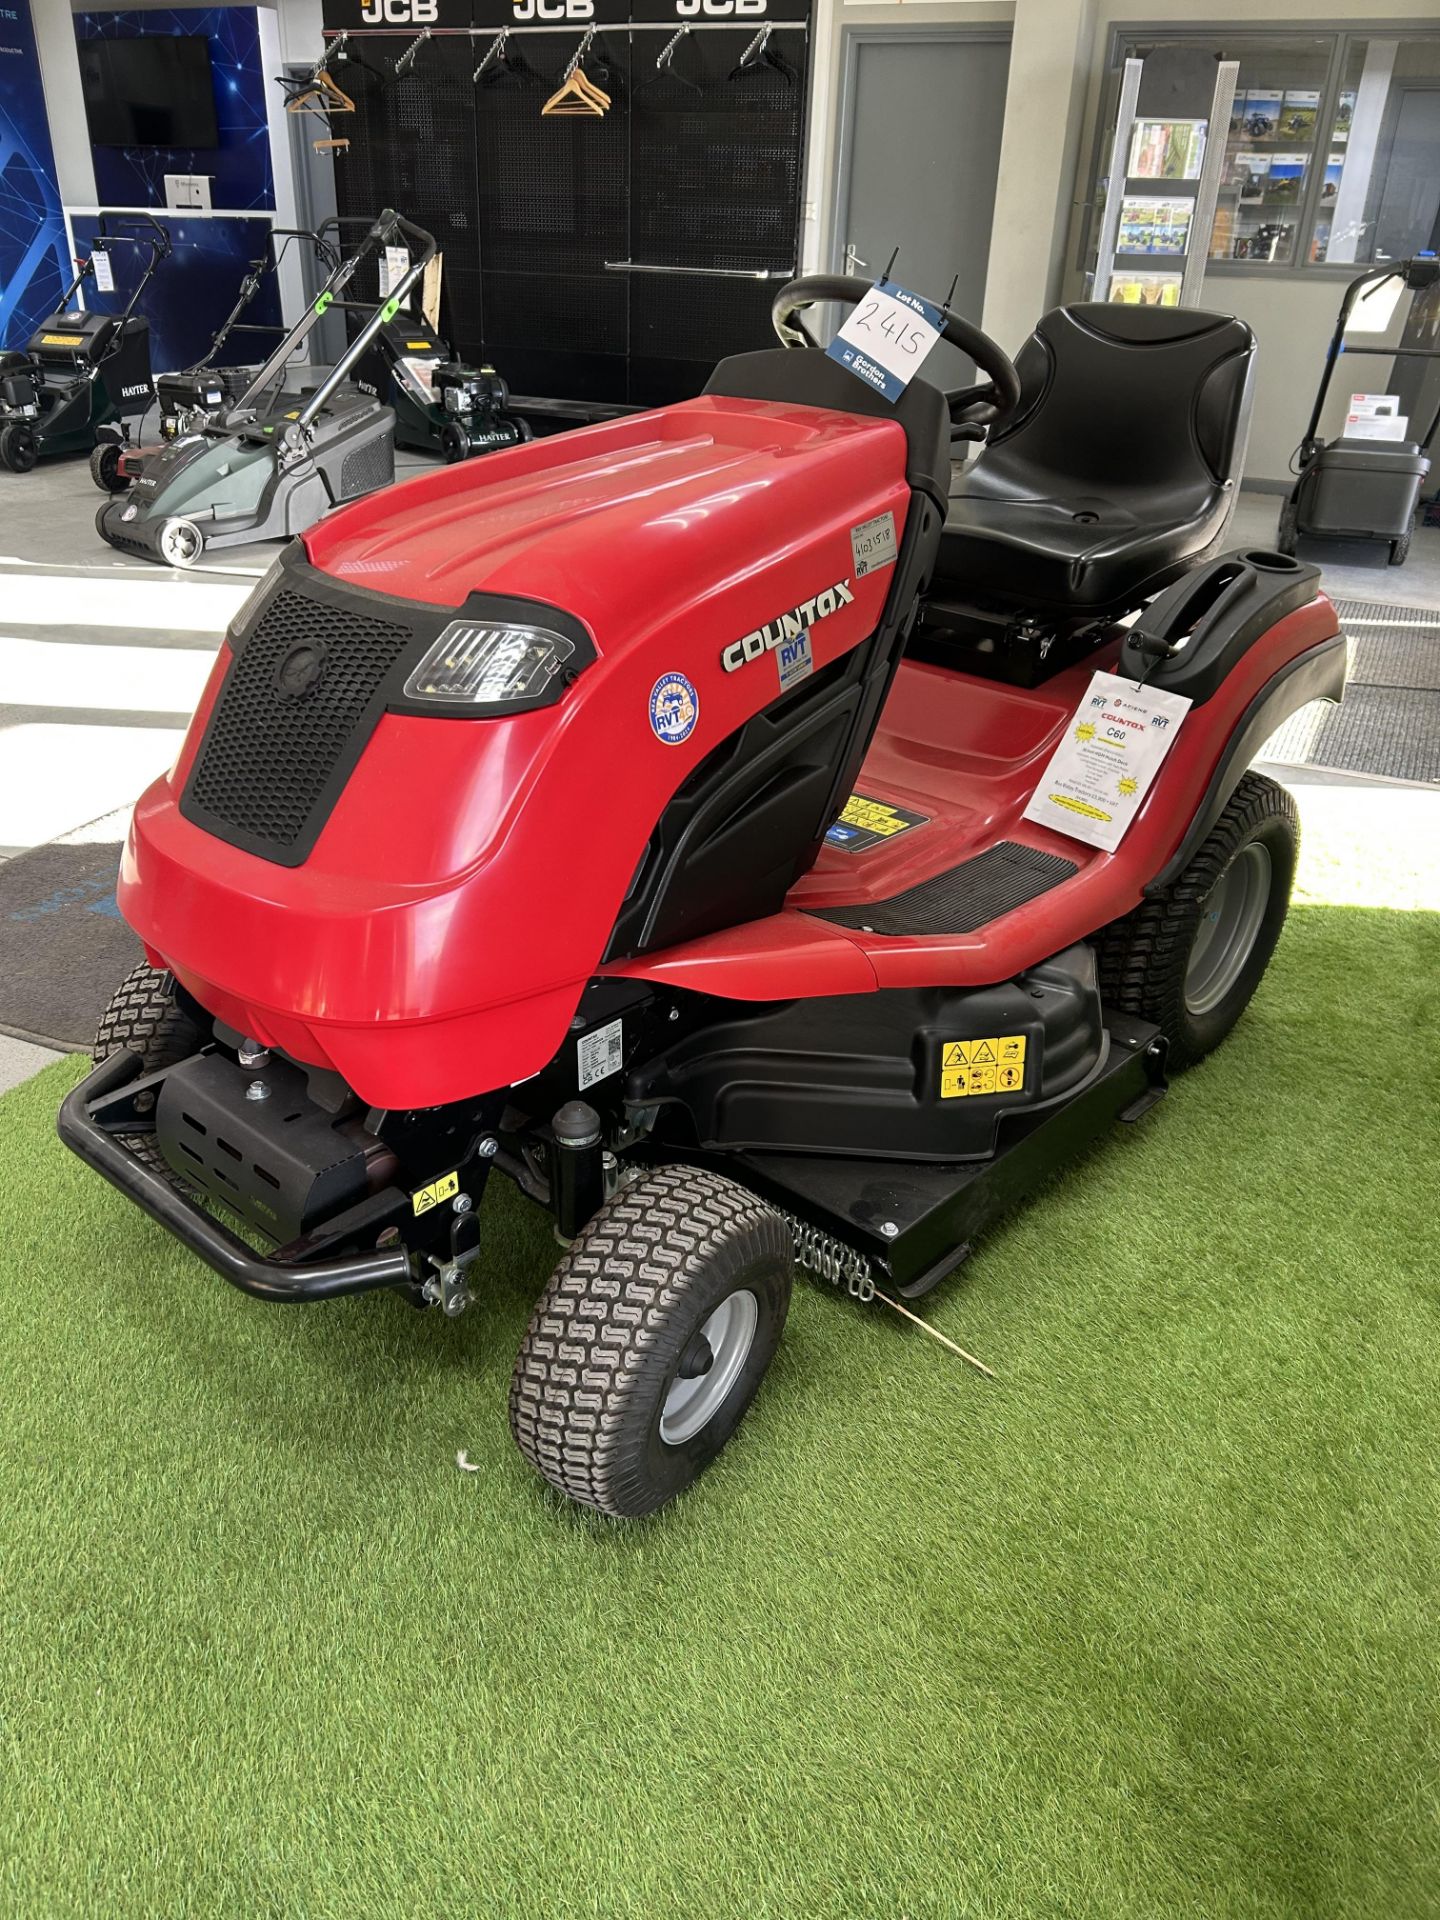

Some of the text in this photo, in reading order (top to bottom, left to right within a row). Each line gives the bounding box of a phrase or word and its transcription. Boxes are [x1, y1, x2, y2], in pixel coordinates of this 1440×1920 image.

[361, 0, 438, 22] JCB
[896, 291, 925, 315] Lot No.
[856, 302, 925, 354] 2415
[852, 361, 886, 390] Brothers
[855, 355, 885, 380] Gordon
[121, 383, 149, 397] HAYTER
[479, 433, 511, 442] HAYTER
[721, 578, 855, 674] COUNTAX
[781, 636, 806, 667] RVT
[653, 677, 669, 697] VALLEY
[670, 675, 695, 697] TRACTORS
[1091, 697, 1107, 708] RVT
[656, 711, 679, 730] RVT
[1101, 712, 1146, 731] COUNTAX
[1151, 717, 1169, 728] RVT
[1106, 727, 1126, 740] C60
